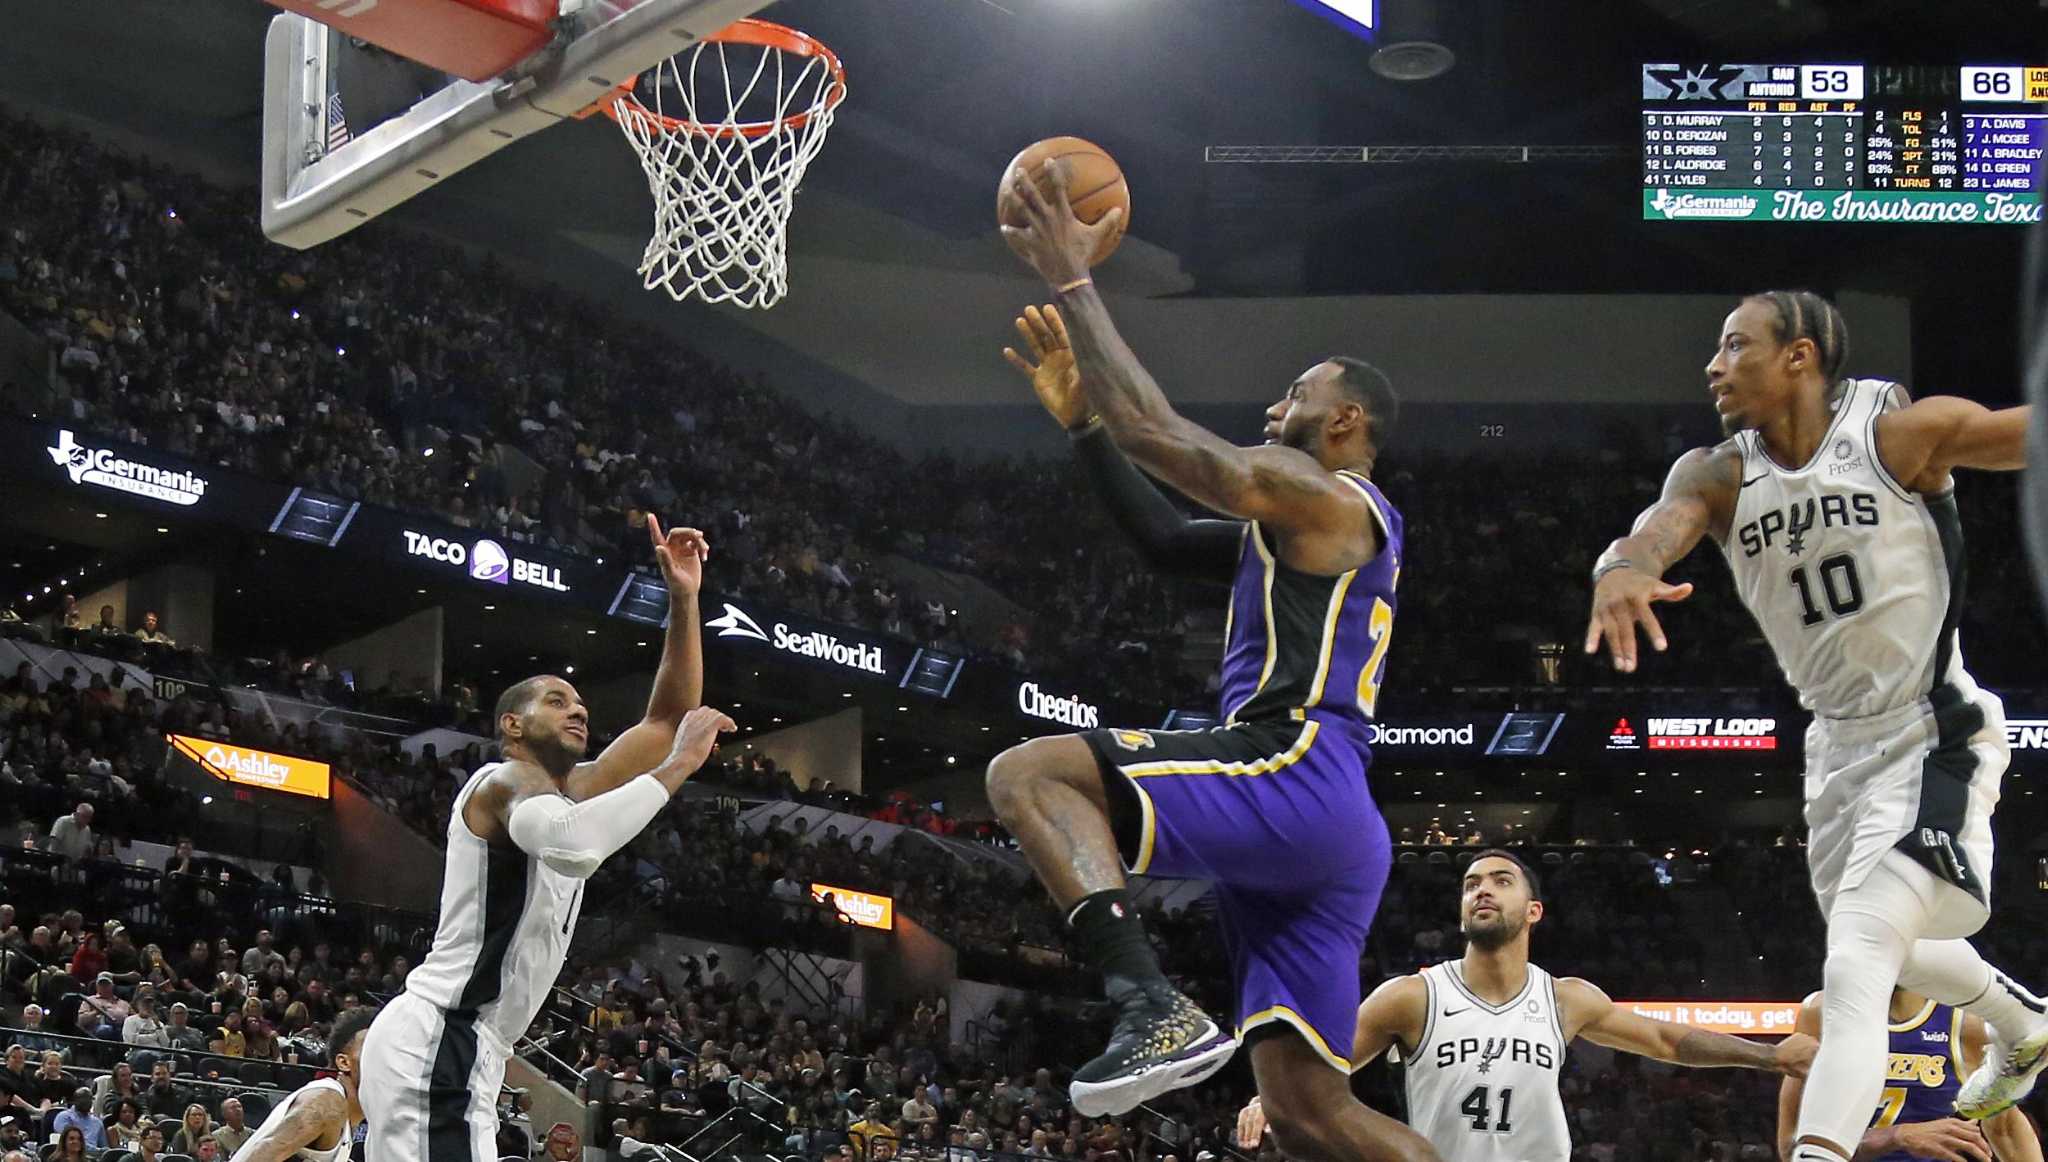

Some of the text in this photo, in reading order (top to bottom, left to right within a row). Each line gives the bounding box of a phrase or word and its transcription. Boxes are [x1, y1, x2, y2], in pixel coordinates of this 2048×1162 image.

[1772, 68, 1795, 80] SAN
[1811, 70, 1848, 92] 53
[1973, 72, 2011, 94] 66
[1749, 83, 1795, 97] ANTONIO
[1810, 102, 1829, 112] AST
[1648, 116, 1656, 125] 5
[1676, 116, 1722, 125] MURRAY
[1754, 117, 1762, 126] 2
[1783, 117, 1791, 126] 6
[1814, 117, 1823, 126] 4
[1846, 118, 1852, 127] 1
[1876, 111, 1947, 121] 2 FLS 1
[1876, 125, 1948, 135] 4 TOL 4
[1966, 120, 1974, 129] 3
[1994, 120, 2025, 129] DAVIS
[1646, 131, 1660, 140] 10
[1676, 131, 1726, 140] DEROZAN
[1754, 132, 1762, 142] 9
[1783, 132, 1791, 142] 3
[1816, 133, 1822, 142] 1
[1845, 133, 1853, 143] 2
[1868, 138, 1956, 148] 35% FG 51%
[1966, 134, 1974, 144] 7
[1993, 134, 2030, 144] MCGEE
[1646, 146, 1659, 155] 11
[1676, 146, 1717, 155] FORBES
[1754, 147, 1762, 156] 7
[1783, 147, 1791, 156] 2
[1814, 147, 1823, 157] 2
[1845, 148, 1853, 157] 0
[1868, 152, 1956, 161] 24% 3PT 31%
[1964, 149, 1977, 158] 11
[1994, 149, 2043, 158] BRADLEY
[1646, 160, 1659, 170] 12
[1674, 160, 1726, 170] ALDRIDGE
[1754, 161, 1762, 170] 6
[1783, 161, 1791, 170] 4
[1814, 161, 1823, 171] 2
[1845, 162, 1853, 172] 2
[1868, 165, 1956, 174] 93% FT 88%
[1964, 163, 1978, 173] 14
[1995, 163, 2030, 173] GREEN
[1644, 175, 1659, 185] 41
[1675, 175, 1706, 185] LYLES
[1754, 176, 1762, 186] 4
[1785, 176, 1791, 186] 1
[1814, 177, 1823, 186] 0
[1846, 177, 1852, 186] 1
[1874, 178, 1952, 188] 11 TURNS 12
[1963, 178, 1978, 188] 23
[1993, 178, 2030, 188] JAMES
[1681, 193, 1756, 209] Germania
[1772, 190, 1826, 220] The
[1831, 190, 1978, 222] Insurance
[1480, 424, 1504, 437] 212
[1828, 456, 1864, 476] Frost
[95, 449, 205, 496] Germania
[1738, 493, 1879, 558] SPURS
[403, 530, 567, 592] TACO BELL
[1789, 551, 1864, 627] 10
[773, 622, 883, 675] SeaWorld
[1019, 682, 1099, 729] Cheerios
[1647, 718, 1776, 736] WEST LOOP
[226, 751, 289, 785] Ashley
[1676, 1006, 1688, 1024] it
[1695, 1006, 1755, 1028] today,
[1761, 1009, 1795, 1028] get
[1437, 1037, 1553, 1075] SPURS
[1460, 1084, 1514, 1133] 41
